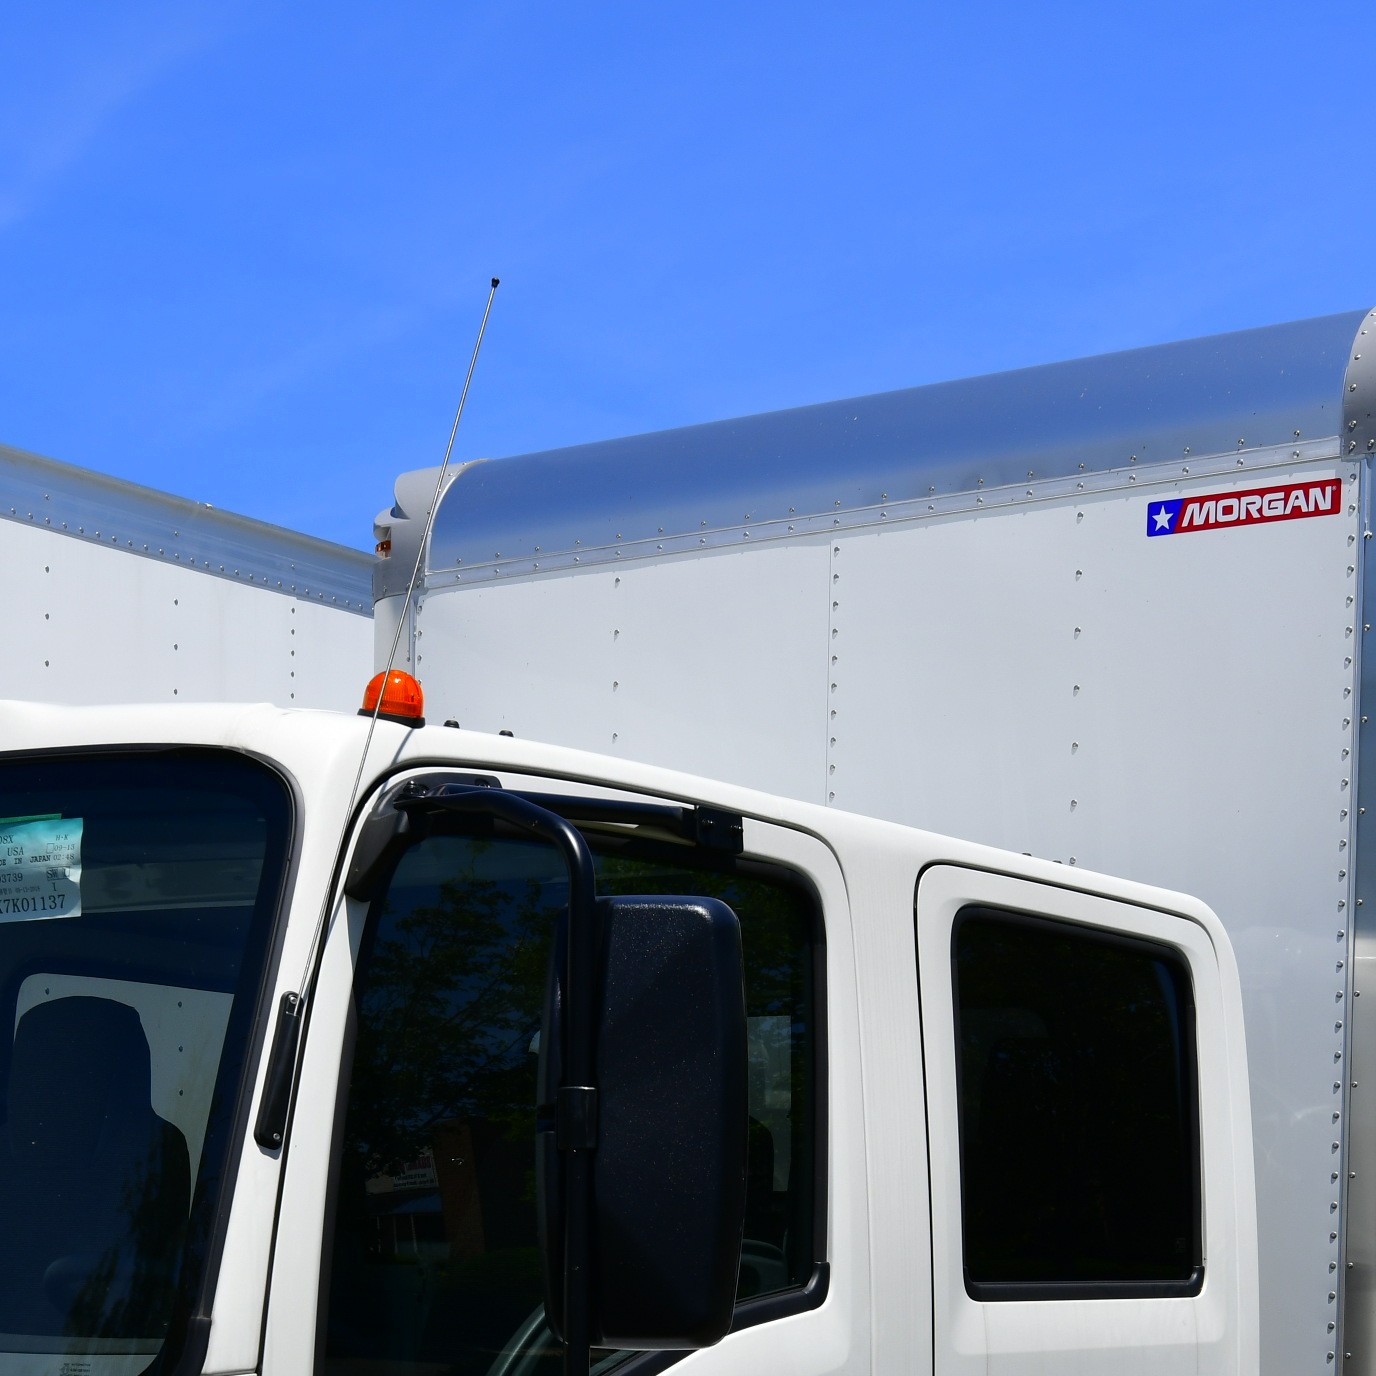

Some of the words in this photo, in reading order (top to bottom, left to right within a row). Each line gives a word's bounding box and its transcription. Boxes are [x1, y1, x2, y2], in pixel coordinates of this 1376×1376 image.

[1181, 485, 1333, 528] MORGAN
[7, 847, 24, 857] USA
[14, 857, 22, 865] IN
[29, 855, 51, 864] JAPAN
